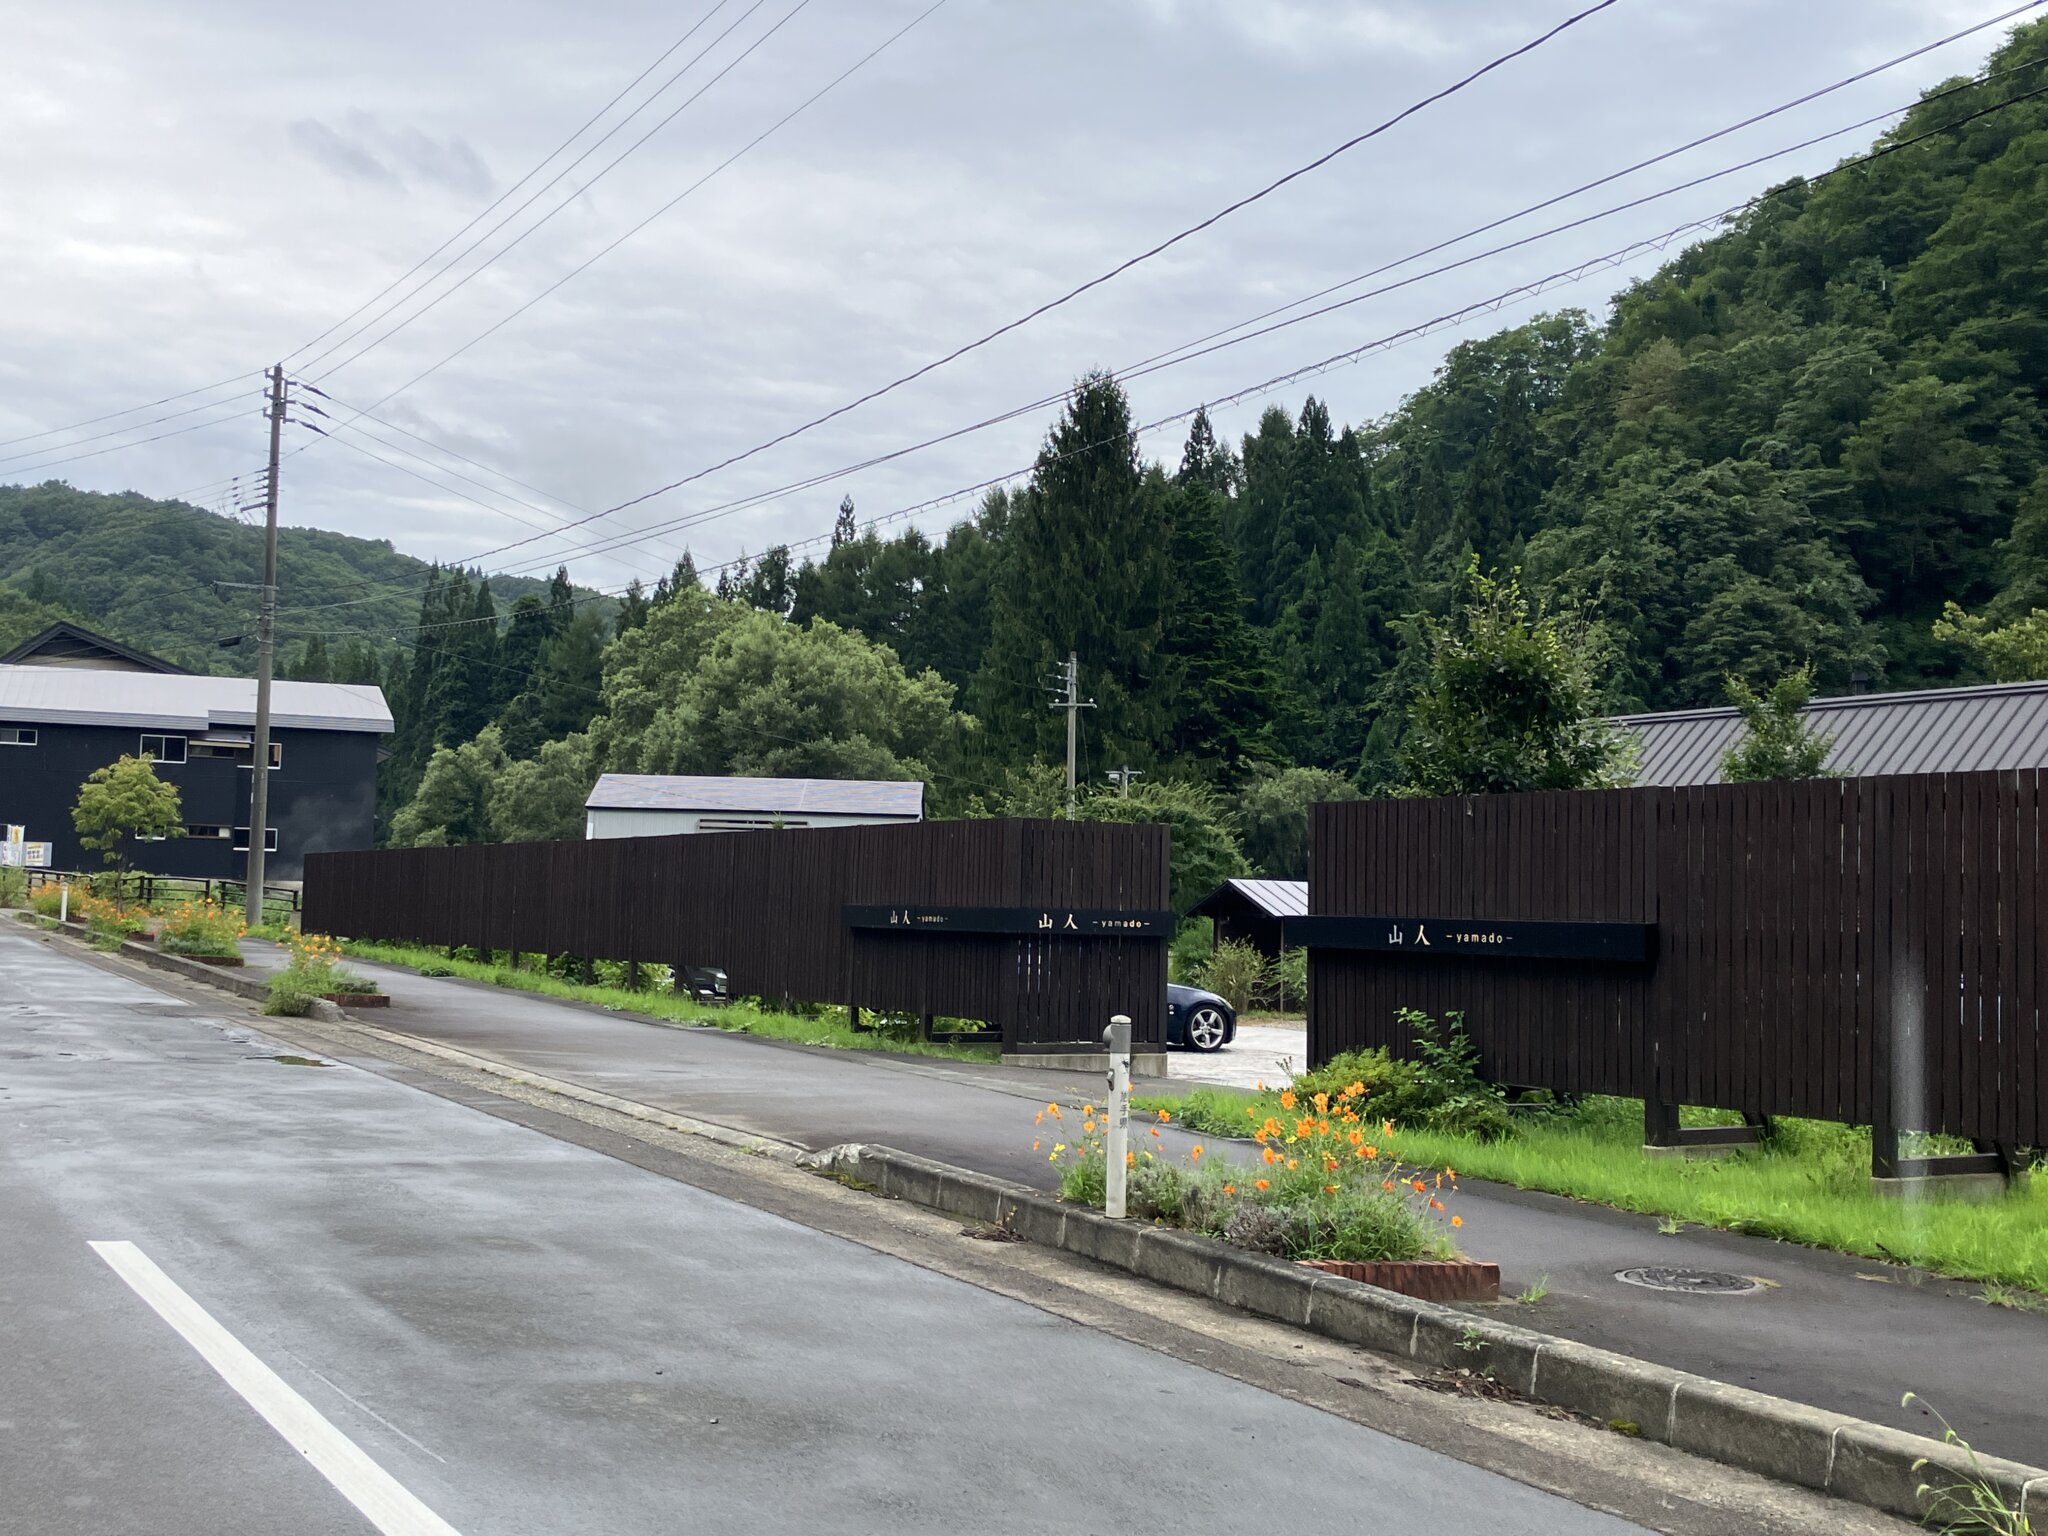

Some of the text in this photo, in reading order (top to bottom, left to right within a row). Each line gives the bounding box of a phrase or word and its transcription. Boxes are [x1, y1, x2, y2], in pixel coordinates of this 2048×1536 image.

[890, 910, 910, 924] 山人
[1038, 913, 1078, 929] 山人
[1388, 924, 1431, 945] 山人
